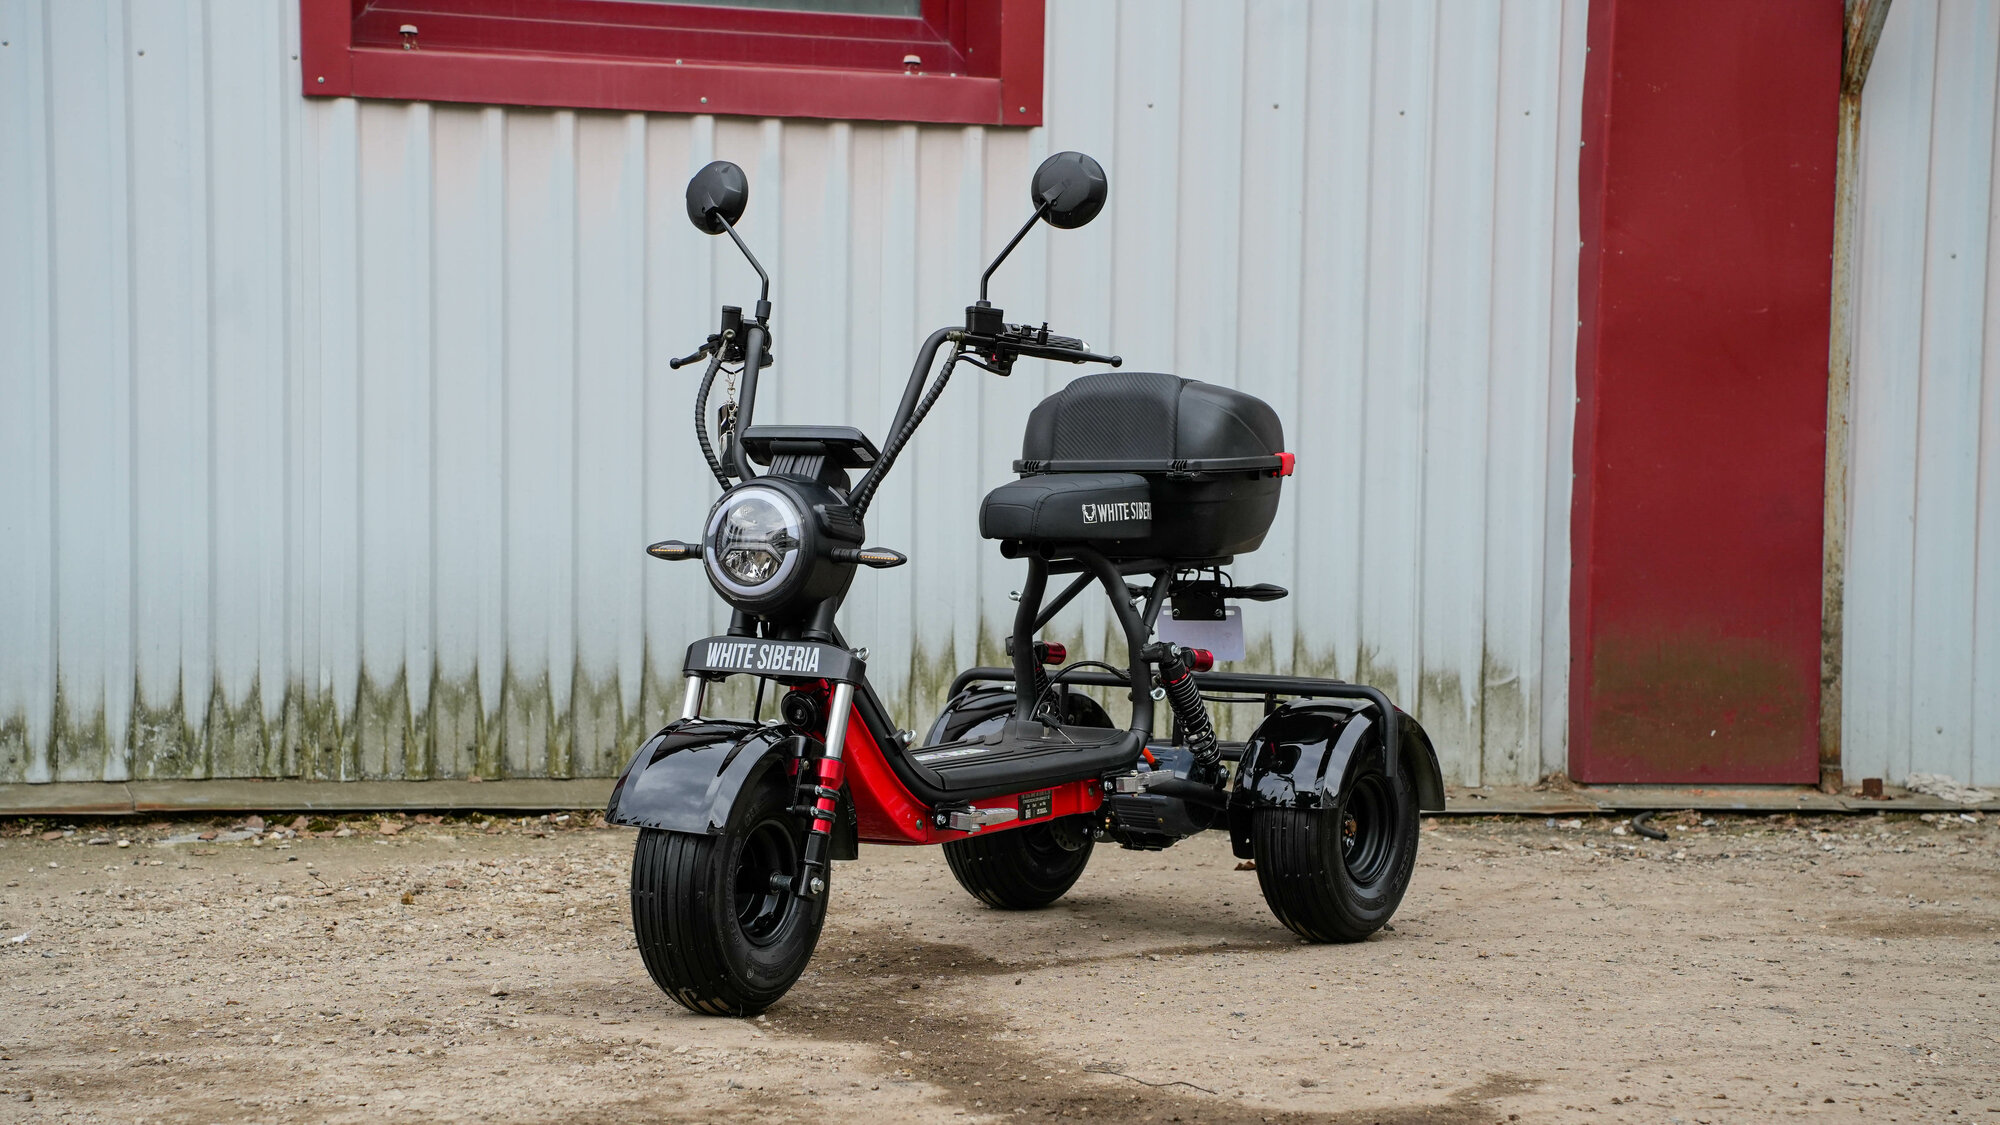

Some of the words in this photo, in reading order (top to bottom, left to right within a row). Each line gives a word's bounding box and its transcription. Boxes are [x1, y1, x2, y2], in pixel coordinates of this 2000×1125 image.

[1097, 503, 1130, 522] WHITE
[1130, 501, 1153, 521] SIBER
[706, 642, 757, 669] WHITE
[757, 644, 820, 673] SIBERIA
